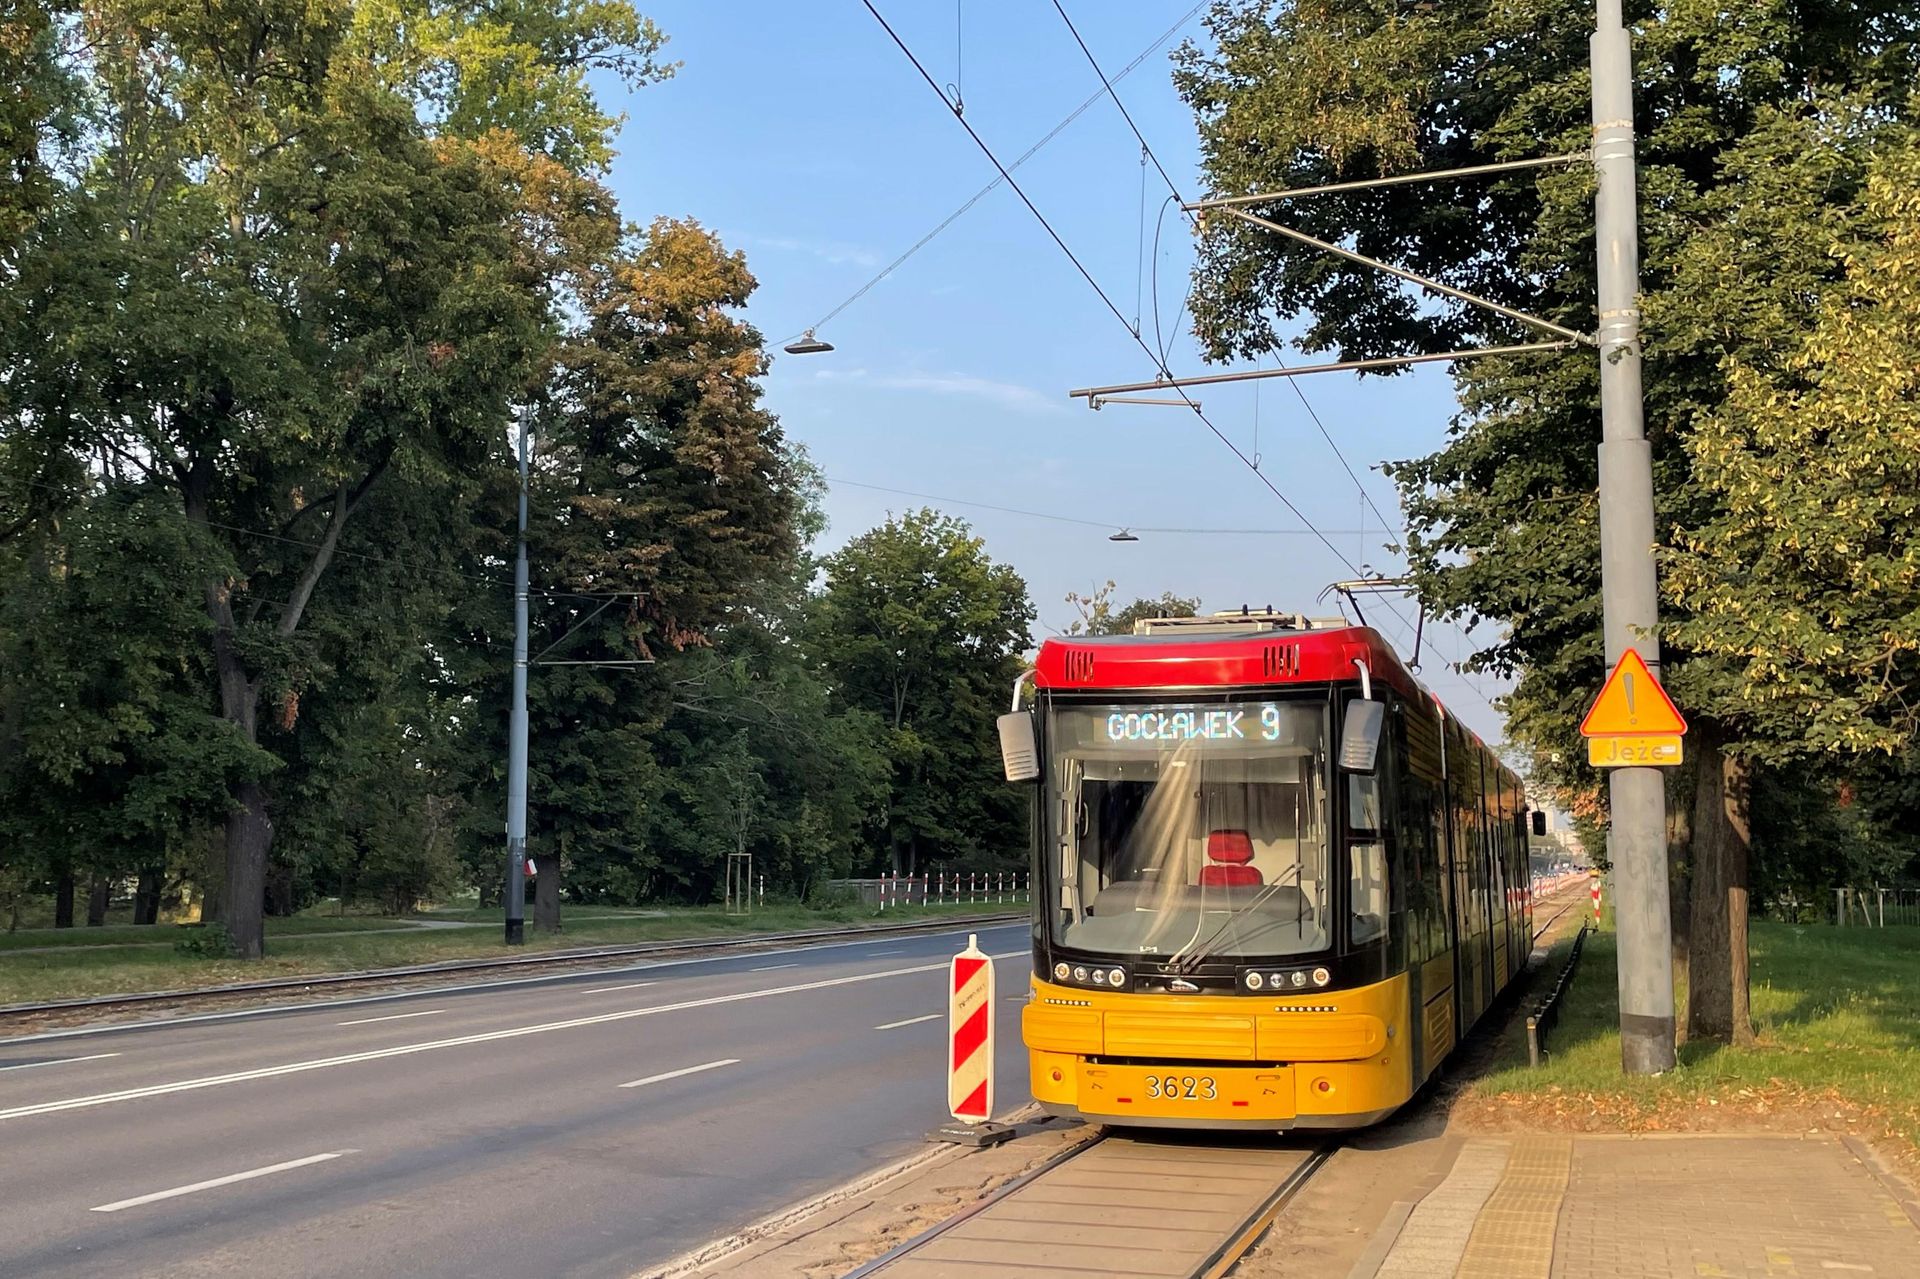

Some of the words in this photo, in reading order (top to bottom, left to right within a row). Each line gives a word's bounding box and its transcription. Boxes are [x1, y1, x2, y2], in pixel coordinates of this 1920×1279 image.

[1107, 710, 1244, 741] GOCŁAWEK
[1261, 707, 1280, 741] 9
[1606, 740, 1664, 761] Jeże
[1145, 1075, 1217, 1100] 3623
